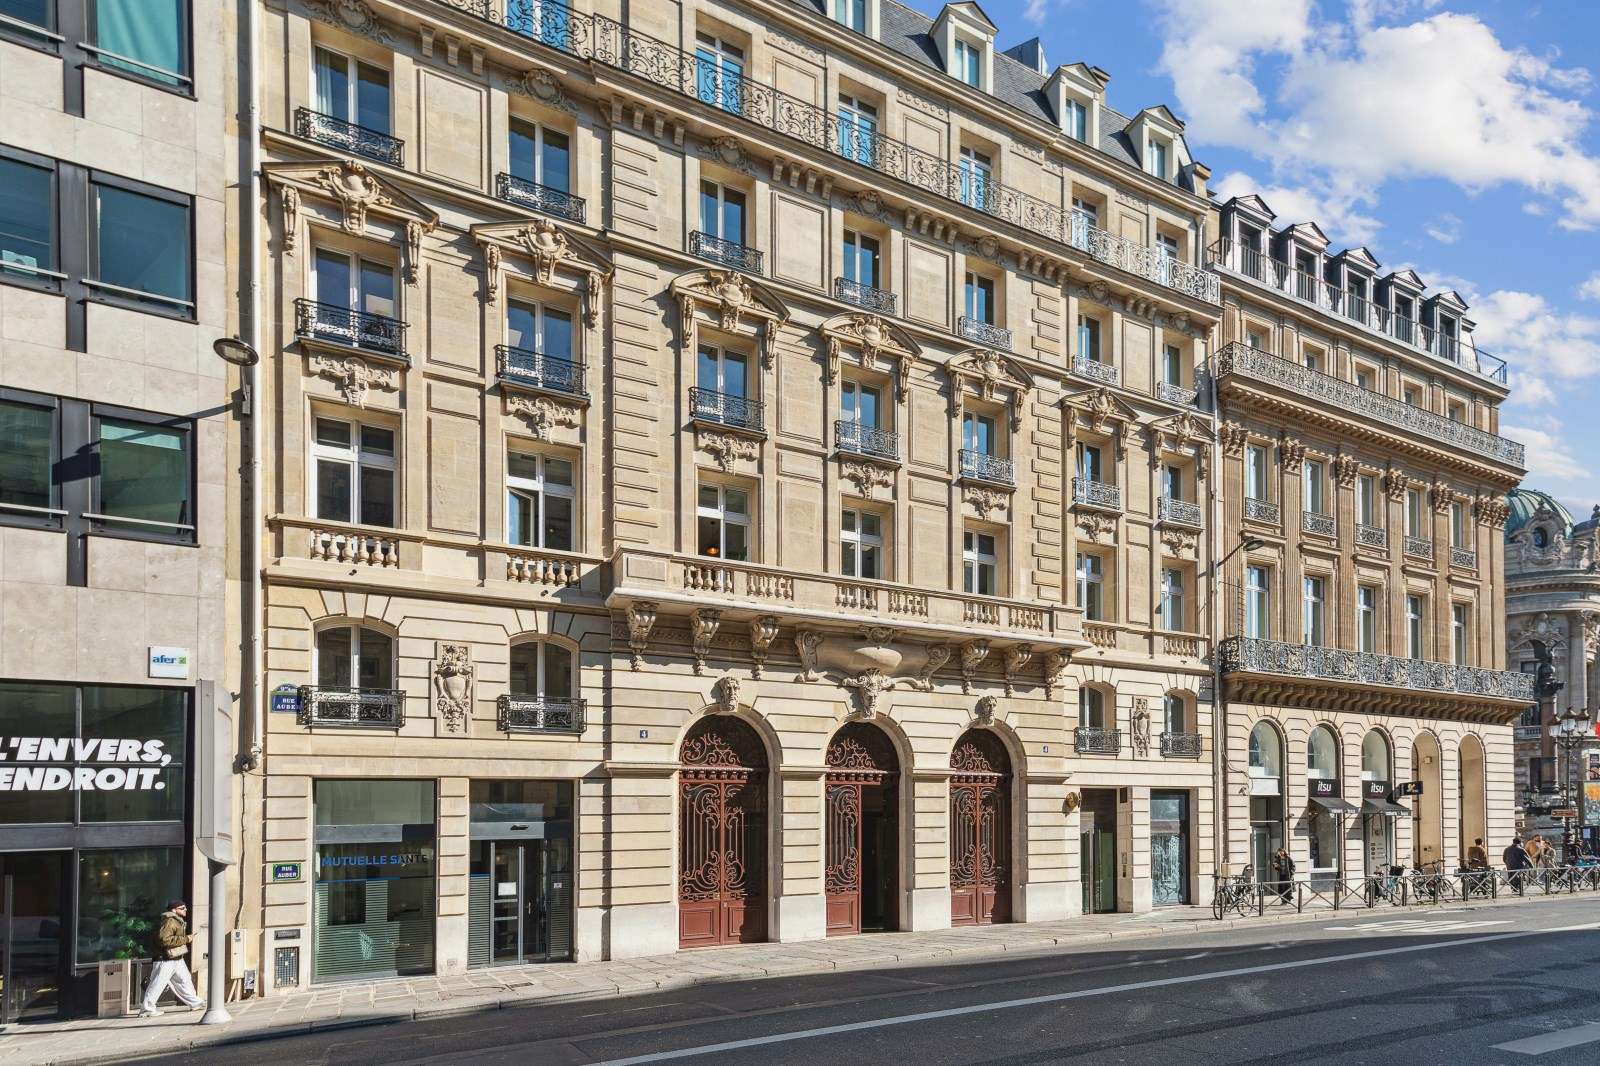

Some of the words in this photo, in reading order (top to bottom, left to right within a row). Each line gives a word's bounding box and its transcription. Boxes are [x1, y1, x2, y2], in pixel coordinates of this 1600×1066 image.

[152, 654, 177, 664] afer
[0, 737, 172, 767] 'ENVERS,
[1317, 781, 1332, 792] itsu
[1370, 782, 1384, 793] itsu
[322, 855, 387, 866] MUTUELLE
